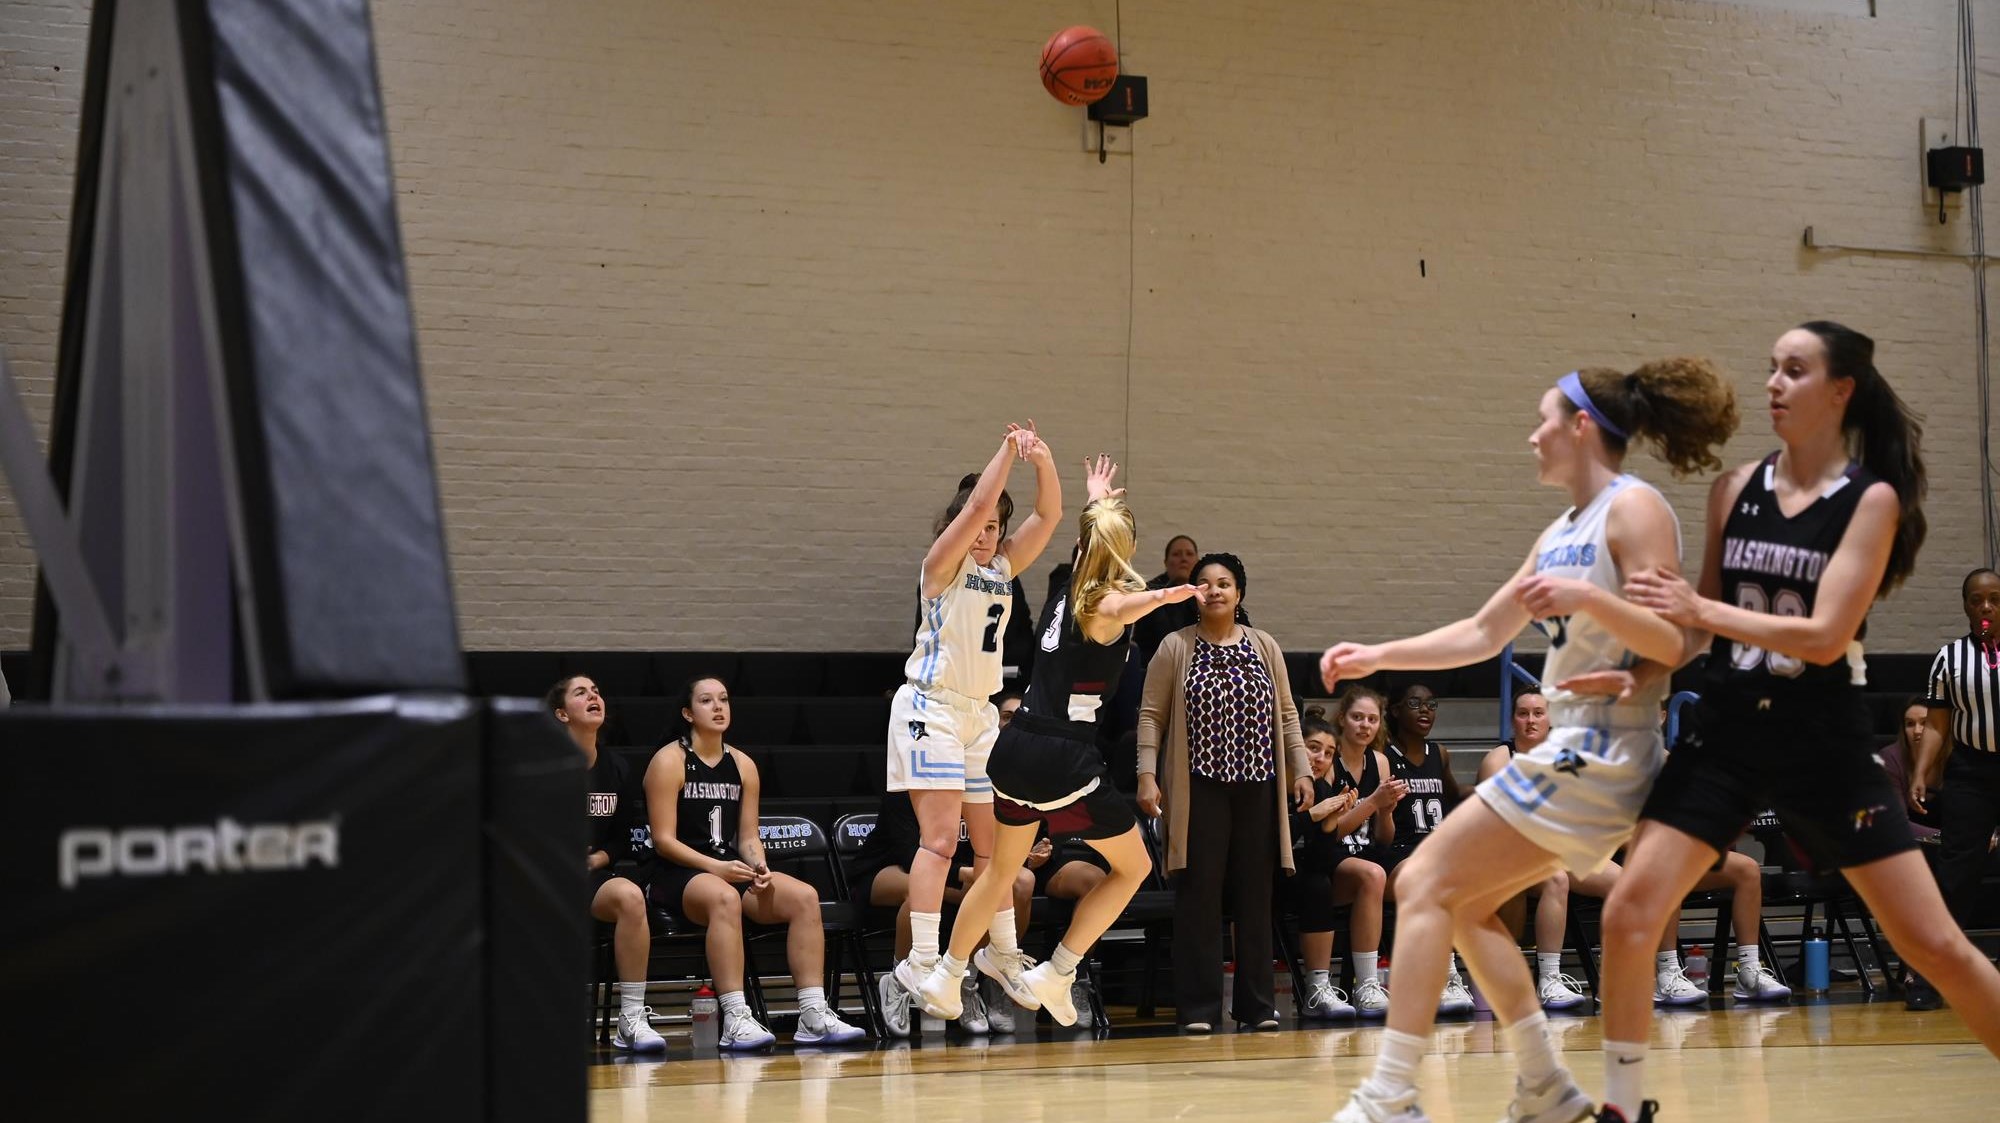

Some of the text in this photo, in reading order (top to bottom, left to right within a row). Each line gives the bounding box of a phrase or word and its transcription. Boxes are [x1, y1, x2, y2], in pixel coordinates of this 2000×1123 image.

[982, 603, 1005, 653] 2
[708, 805, 724, 846] 1
[758, 823, 812, 839] PKINS
[762, 839, 807, 849] HLETICS
